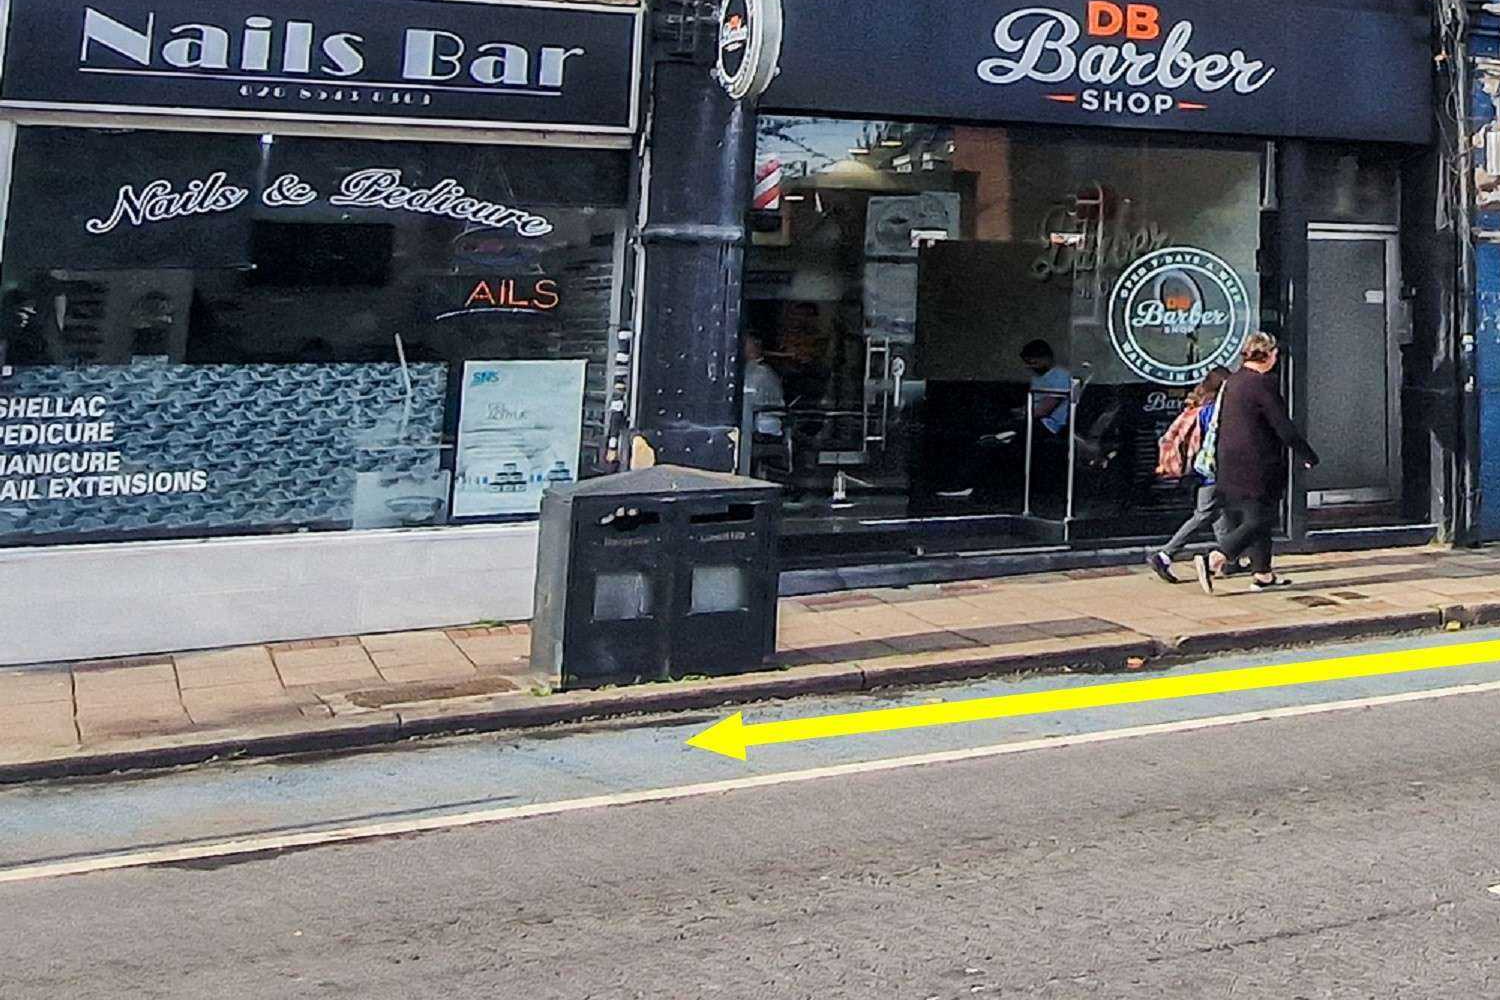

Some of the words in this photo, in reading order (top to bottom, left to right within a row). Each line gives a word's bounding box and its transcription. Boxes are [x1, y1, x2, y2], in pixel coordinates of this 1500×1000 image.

[1087, 0, 1160, 39] DB
[80, 6, 365, 77] Nails
[402, 28, 585, 88] Bar
[976, 6, 1276, 94] Barber
[1081, 88, 1173, 116] SHOP
[85, 171, 248, 233] Nails
[262, 174, 317, 206] &
[329, 168, 552, 237] Pedicure
[1165, 253, 1200, 264] DAYS
[464, 279, 559, 309] AILS
[1132, 299, 1229, 327] Barber
[0, 395, 107, 419] SHELLAC
[0, 479, 42, 500] AIL
[49, 470, 208, 498] EXTENSIONS
